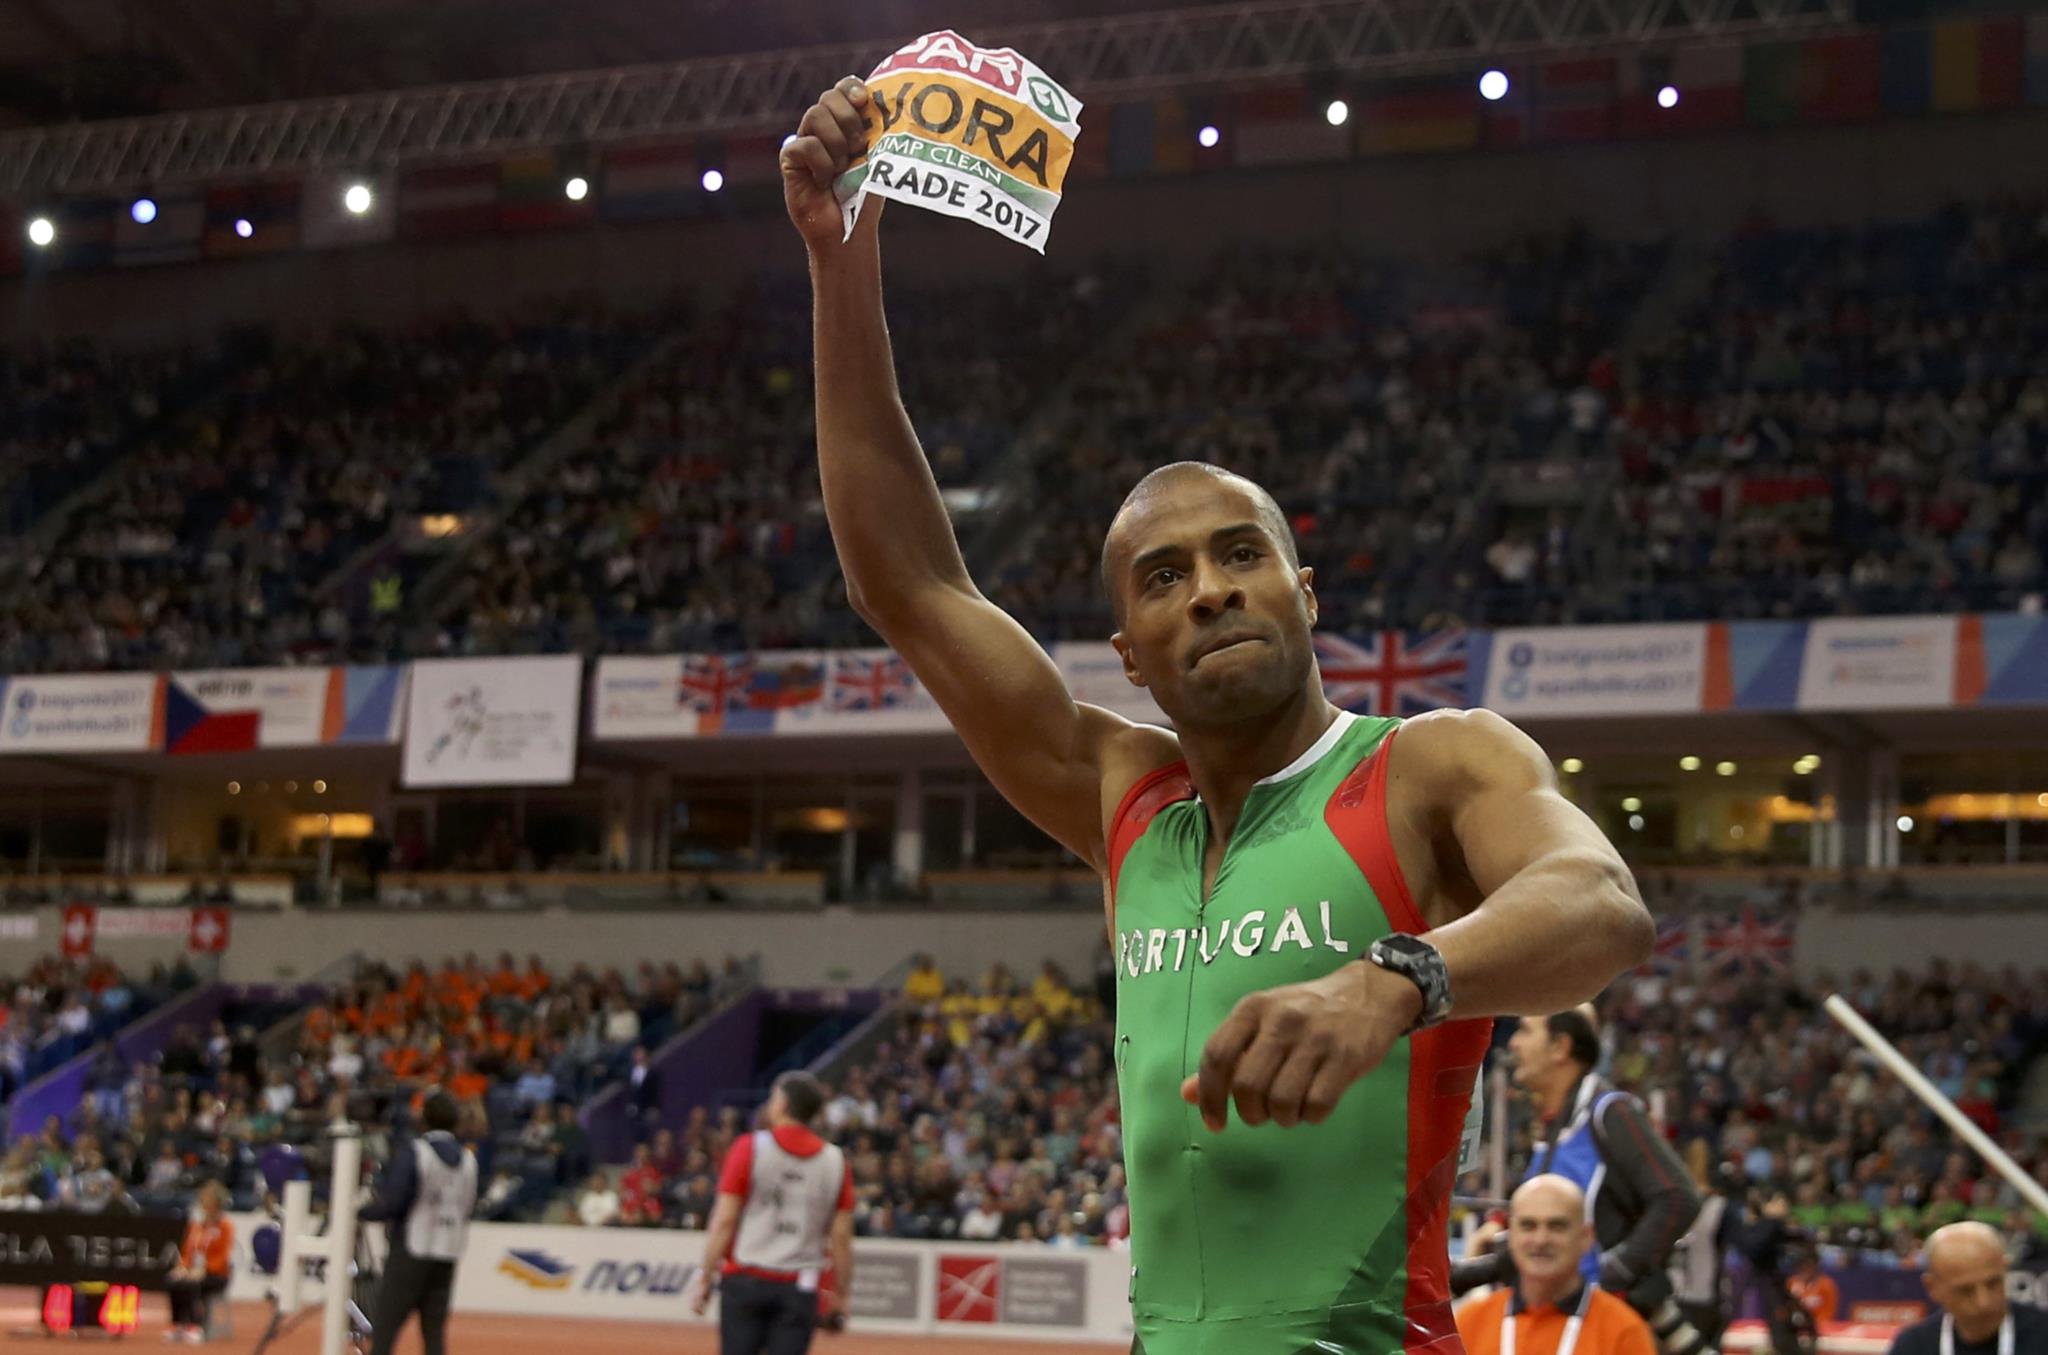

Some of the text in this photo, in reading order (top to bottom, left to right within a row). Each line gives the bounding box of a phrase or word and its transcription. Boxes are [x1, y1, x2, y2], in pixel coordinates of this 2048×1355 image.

[862, 82, 1049, 188] VORA
[872, 136, 1002, 185] UMP CLEAN
[975, 189, 1041, 241] 2017
[66, 1234, 183, 1270] TESLA
